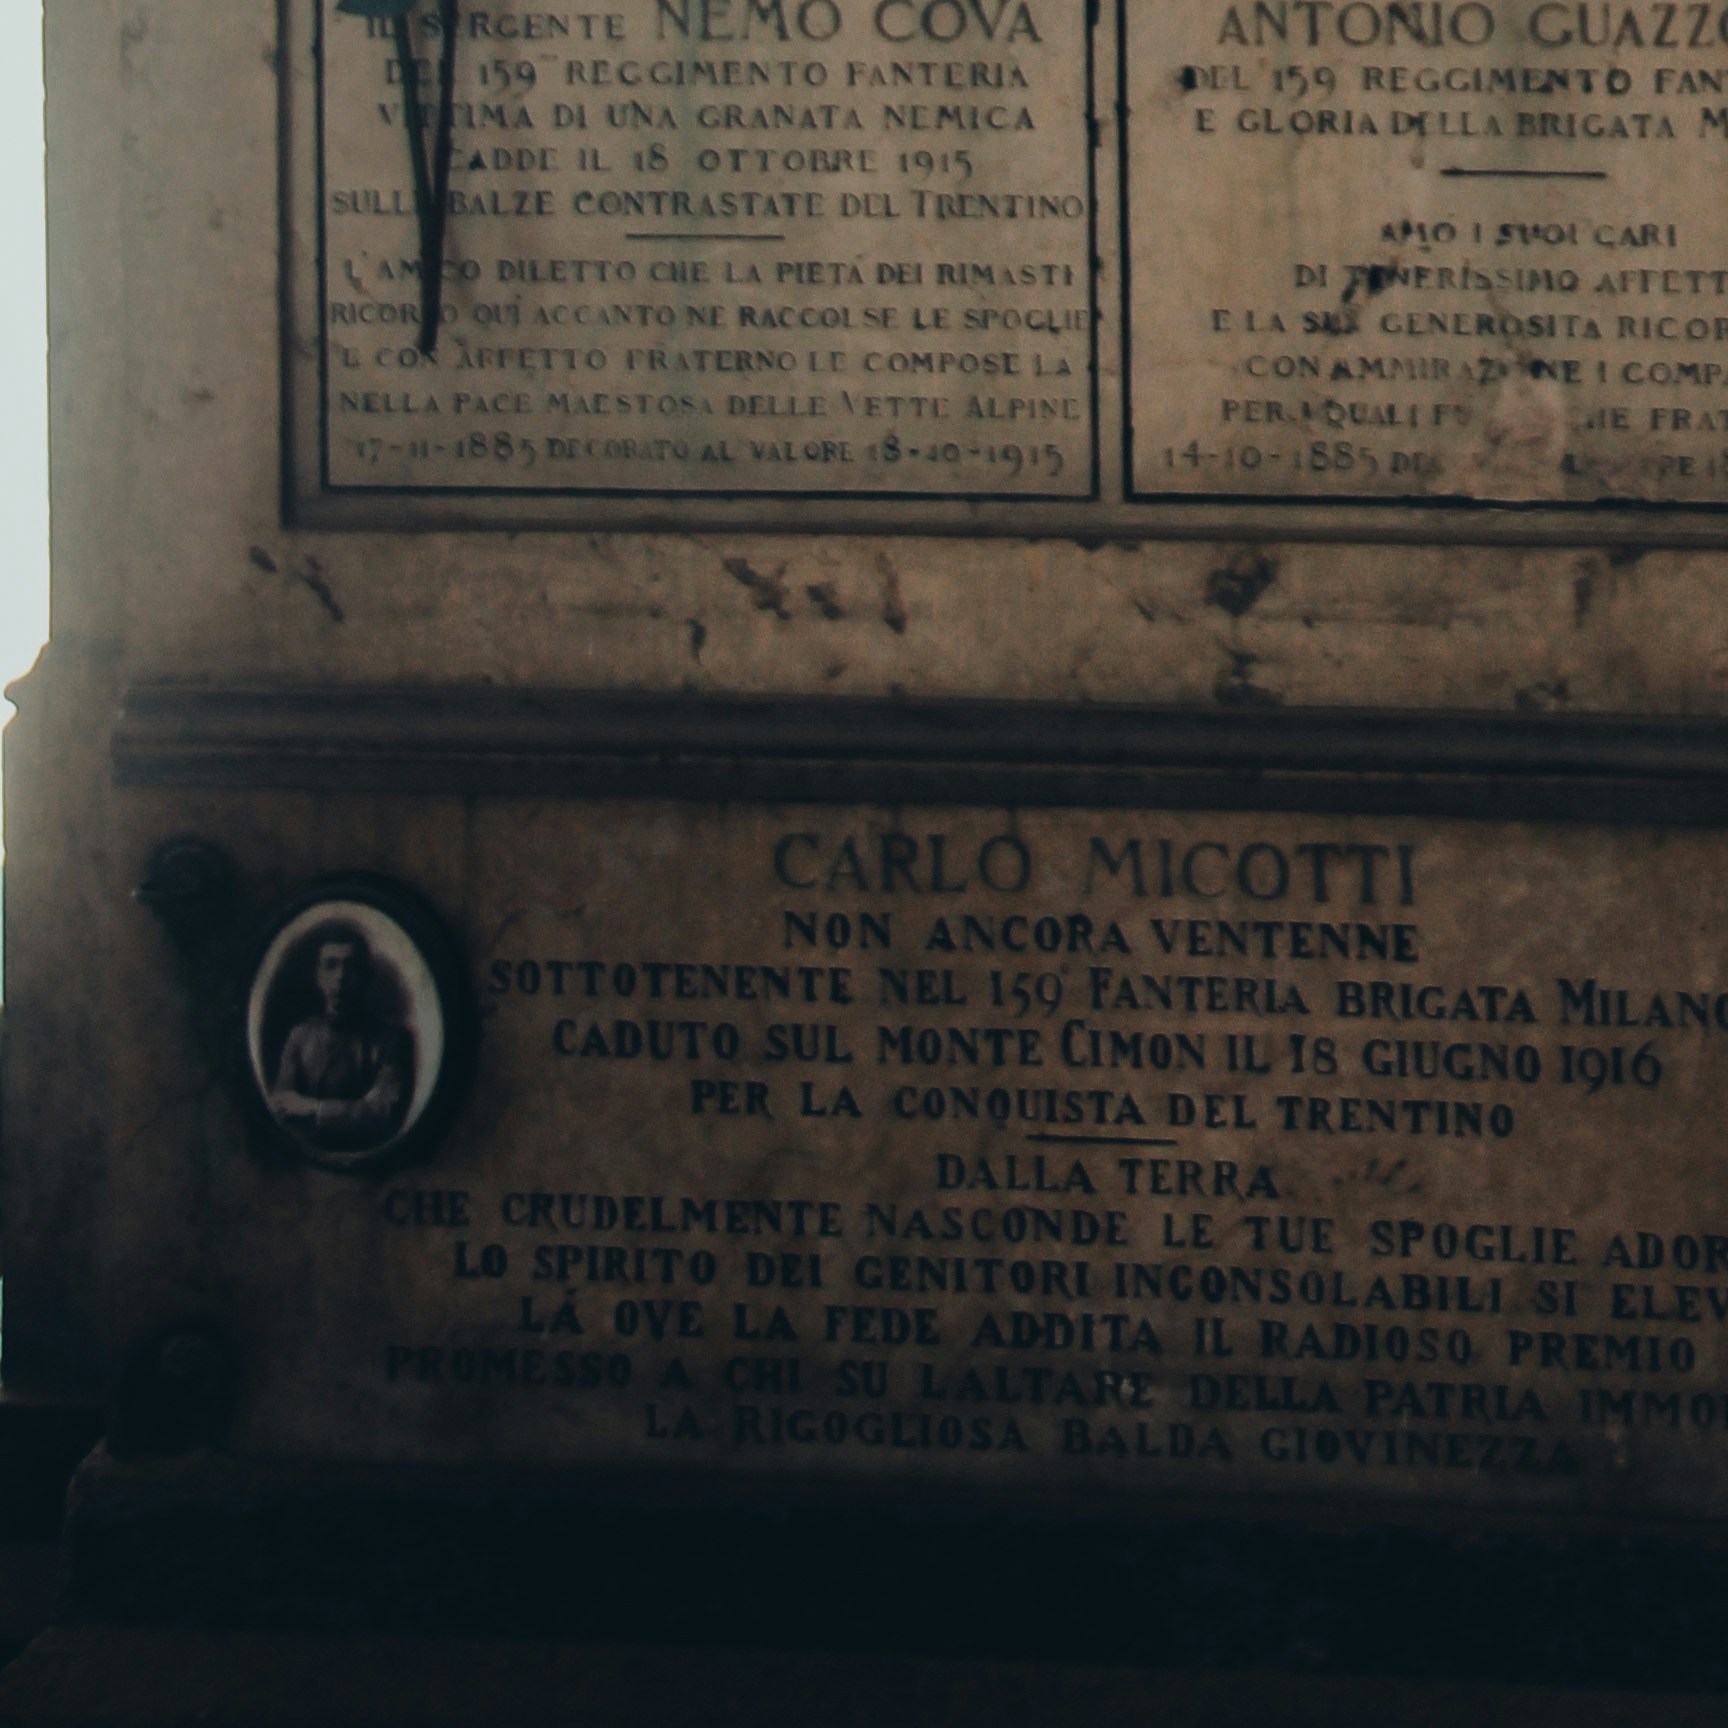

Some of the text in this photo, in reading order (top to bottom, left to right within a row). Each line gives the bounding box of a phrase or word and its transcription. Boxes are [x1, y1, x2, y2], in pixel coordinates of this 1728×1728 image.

[1218, 0, 1495, 48] ANTONIO
[566, 60, 1028, 89] REGGIMENTO FANTERIA
[554, 100, 1034, 131] DI UNA GRANATA NEMICA
[1197, 109, 1213, 133] E
[1237, 109, 1378, 137] GLORIA
[1516, 112, 1674, 139] BRIGATA
[579, 144, 973, 180] IL 18 OTTOBRE 1915
[772, 832, 1417, 909] CARLO MICOTTI
[784, 912, 1418, 963] NON ANCORA VENTENNE
[487, 960, 854, 1006] SOTTOTENENTE
[879, 968, 967, 1005] NEL
[1089, 967, 1310, 1016] FANTERIA
[1336, 982, 1537, 1024] BRIGATA
[552, 1019, 1663, 1095] CADUTO SUL MONTE CIMON IL 18 GIUGNO 1916
[691, 1079, 1514, 1138] PER LA CONQUISTA DEL TRENTINO
[936, 1153, 1280, 1202] DALLA TERRA
[382, 1190, 469, 1228] CHE
[501, 1191, 843, 1243] CRUDELMENTE
[866, 1203, 1128, 1246] NASCONDE
[1164, 1214, 1215, 1249] LE
[1241, 1216, 1333, 1254] TUE
[1369, 1219, 1578, 1265] SPOGLIE
